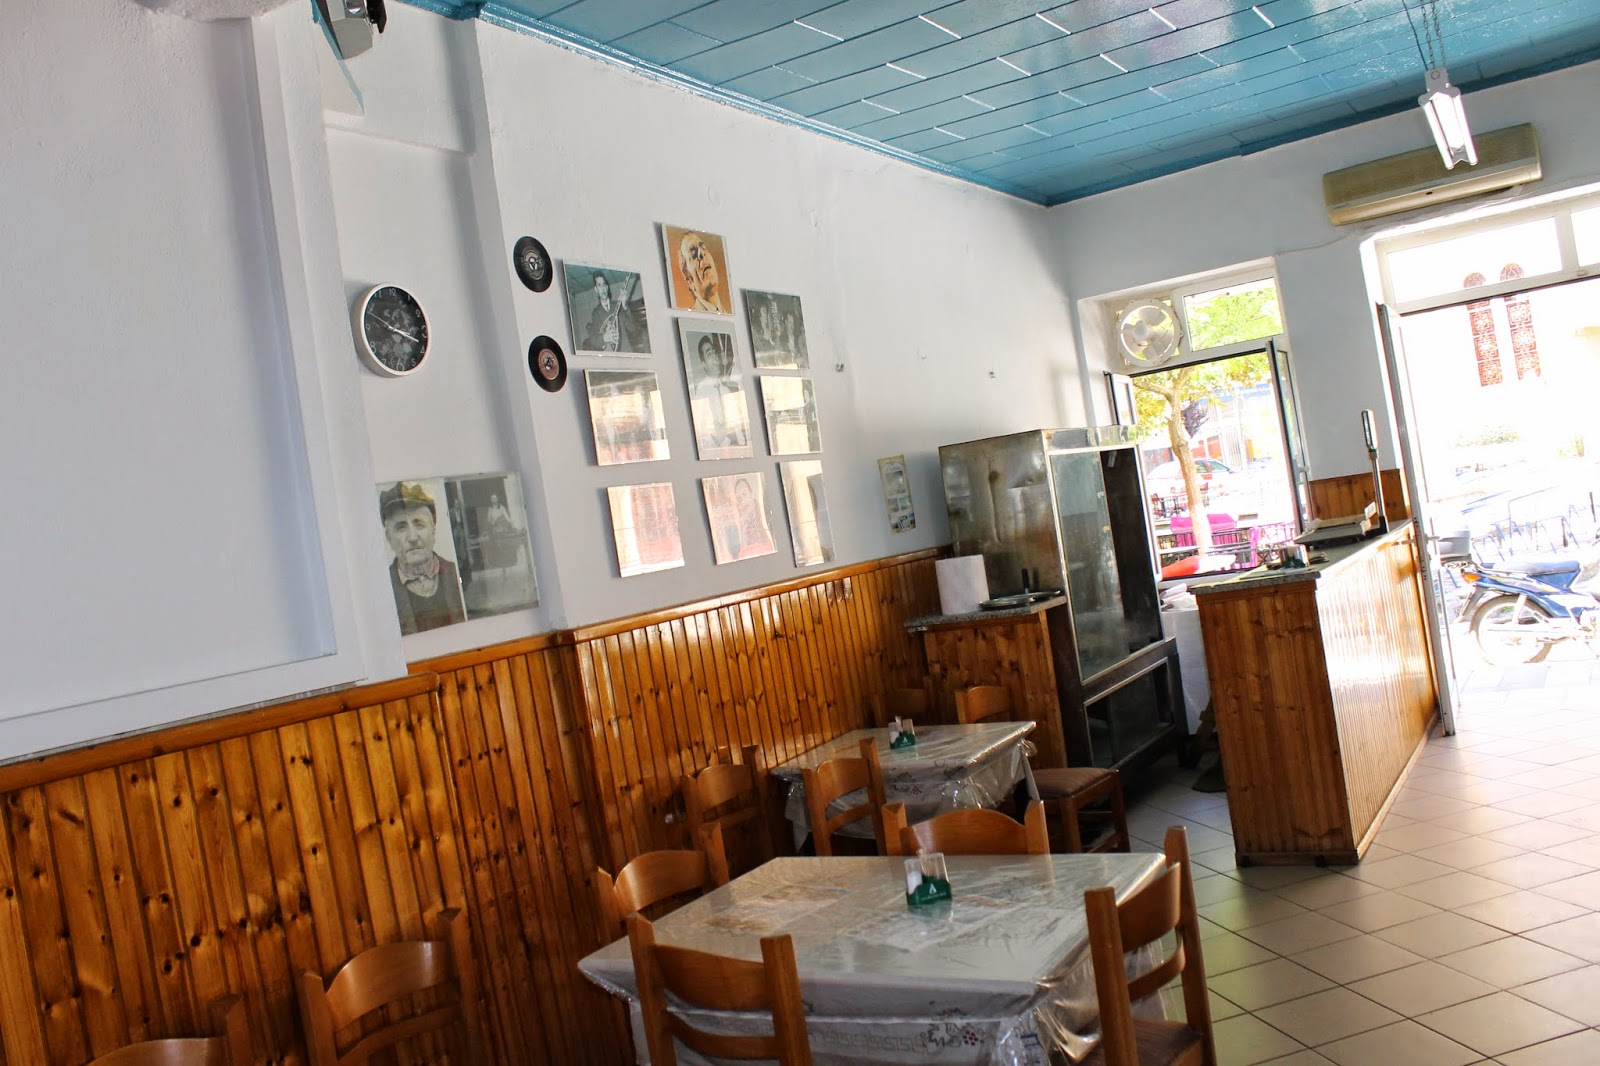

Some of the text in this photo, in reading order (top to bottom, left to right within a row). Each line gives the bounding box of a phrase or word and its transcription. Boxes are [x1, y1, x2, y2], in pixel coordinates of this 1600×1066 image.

[388, 288, 397, 297] 12
[415, 309, 421, 317] 2
[421, 325, 428, 338] 3
[369, 341, 377, 354] 8
[396, 357, 405, 371] 6
